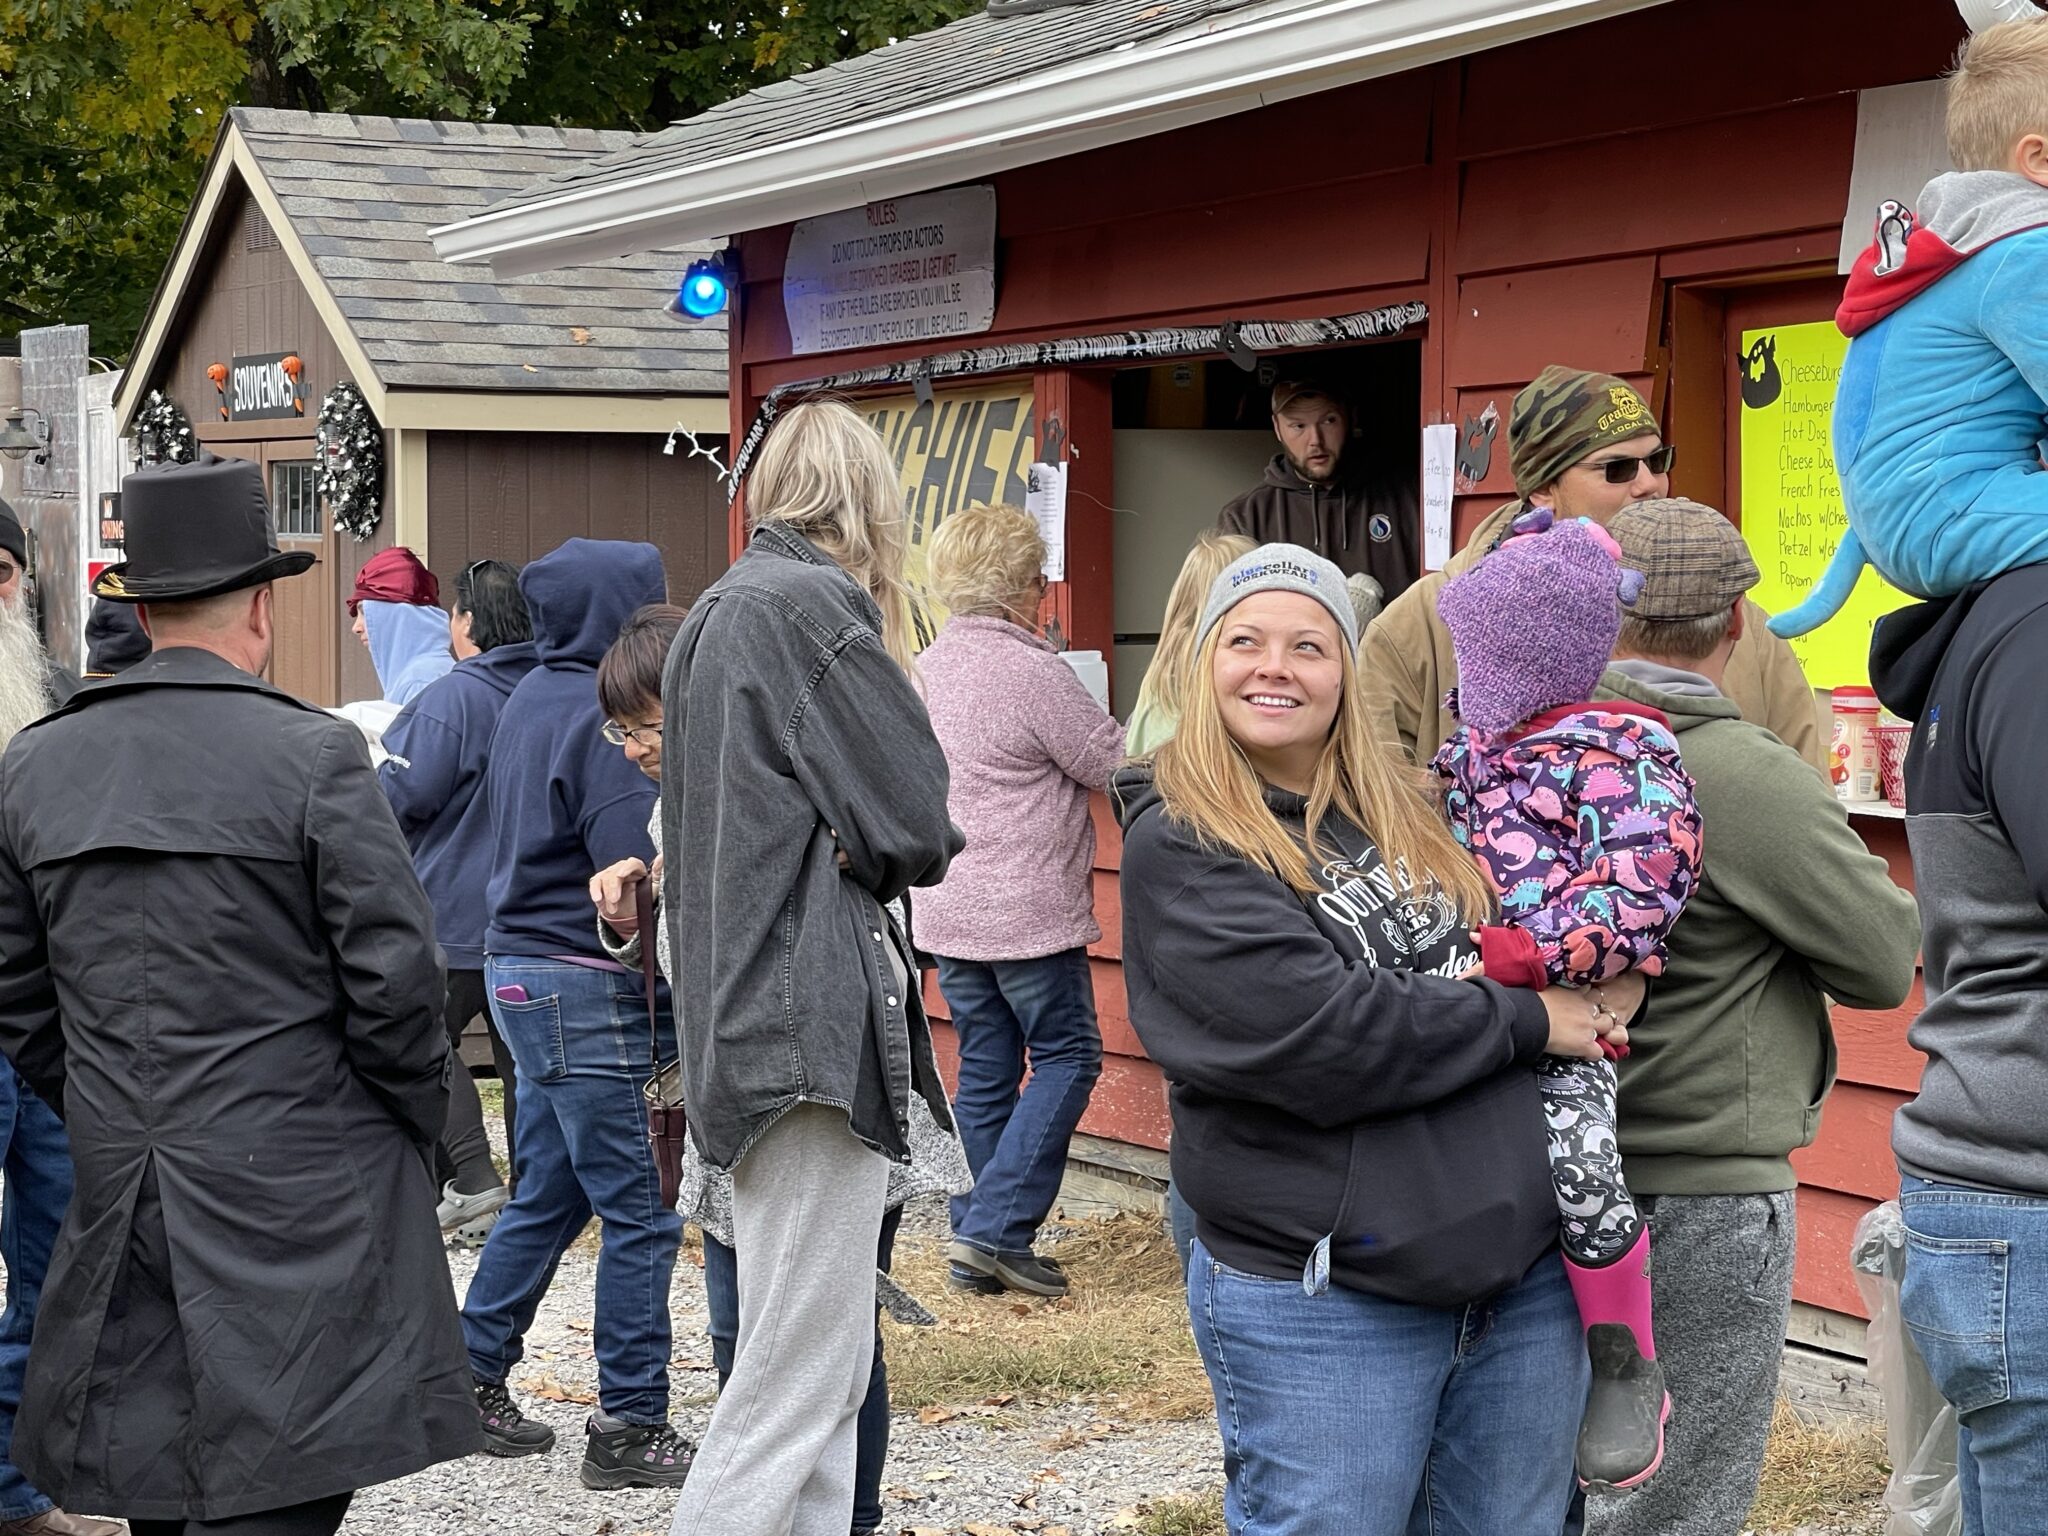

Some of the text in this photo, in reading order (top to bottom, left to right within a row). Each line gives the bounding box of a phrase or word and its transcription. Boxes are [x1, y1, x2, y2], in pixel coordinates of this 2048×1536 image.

[832, 224, 944, 264] DO NOT TOUCH PROPS OR ACTORS
[928, 256, 942, 279] GET
[892, 289, 919, 311] BROKEN
[920, 286, 934, 307] YOU
[934, 284, 951, 304] WILL
[951, 282, 962, 302] BE
[892, 319, 915, 340] POLICE
[931, 314, 941, 335] BE
[1783, 388, 1835, 417] Hamburger
[1611, 420, 1642, 436] LOCAL
[1783, 419, 1828, 447] Hot Dog
[1779, 444, 1834, 475] Cheese Dog
[1780, 473, 1841, 499] French Fries
[1778, 502, 1812, 528] Nachos
[1778, 530, 1812, 556] Pretzel
[1780, 560, 1812, 592] Popcorn
